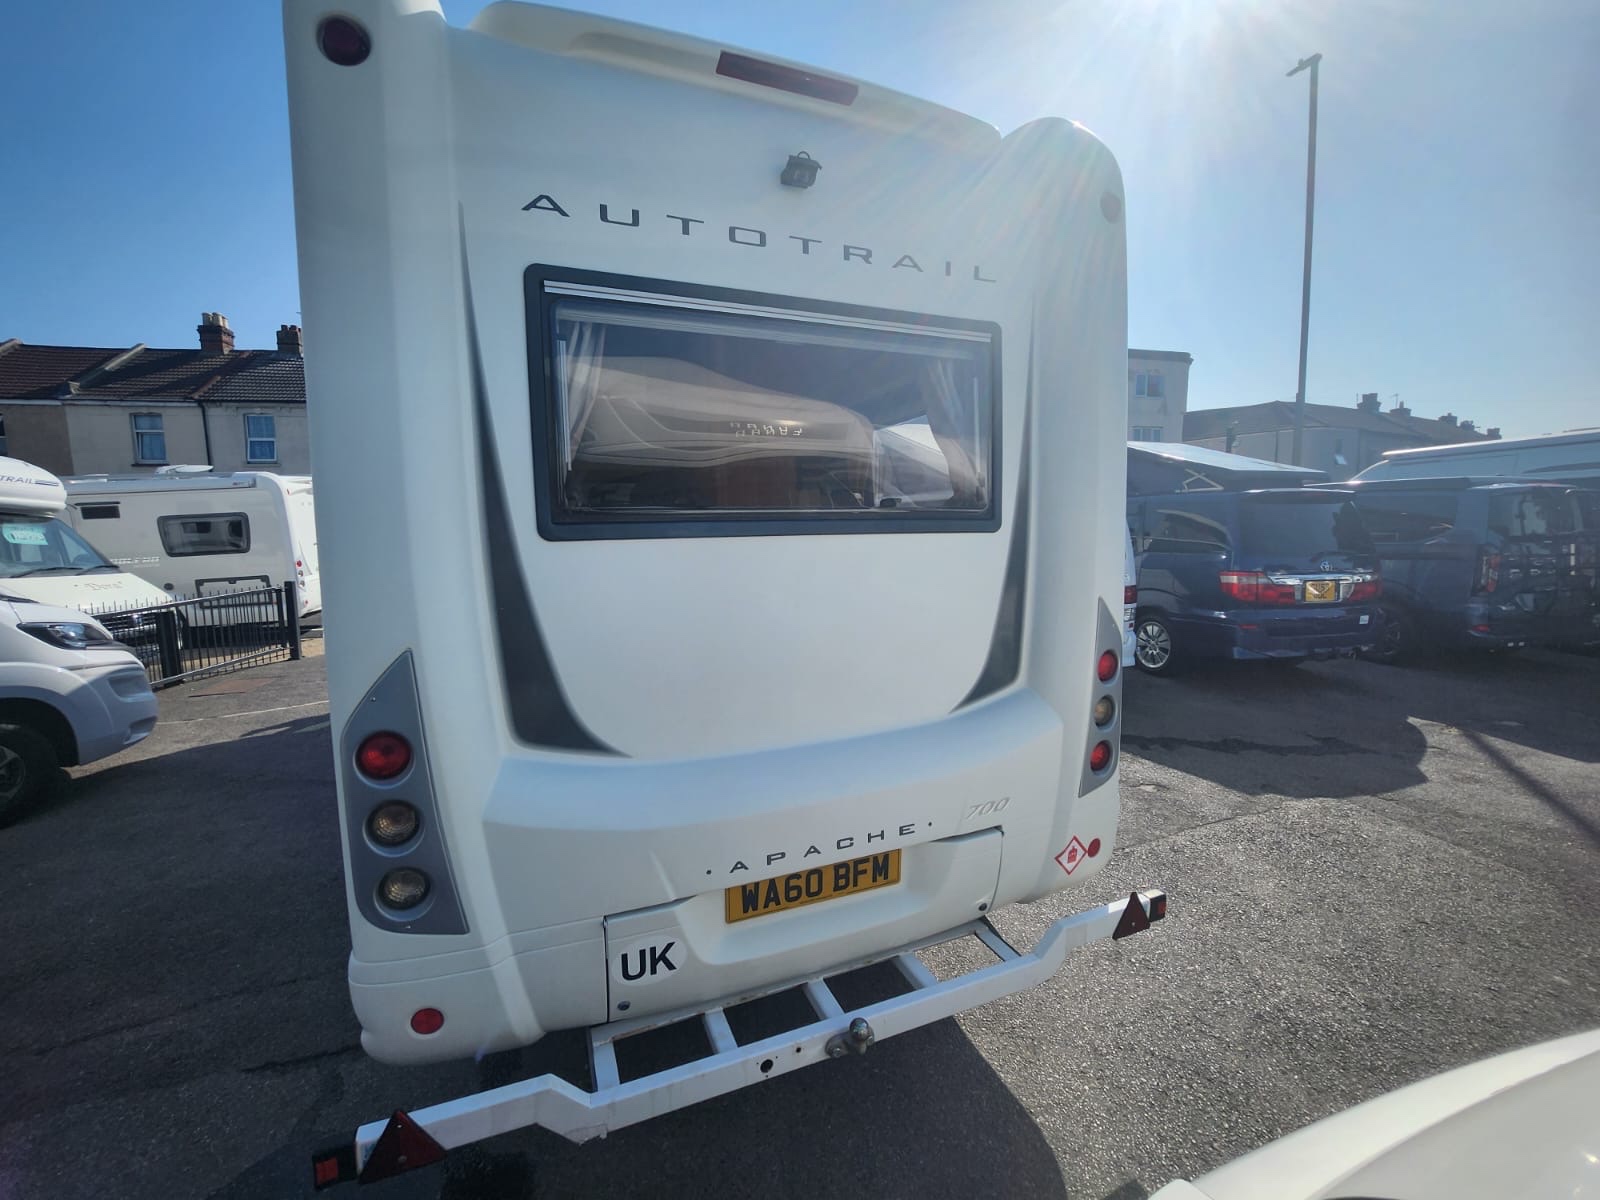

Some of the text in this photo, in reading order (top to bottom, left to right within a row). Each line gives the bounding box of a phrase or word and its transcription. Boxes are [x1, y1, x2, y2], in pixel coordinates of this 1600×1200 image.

[521, 194, 997, 283] AUTOTRAIL
[966, 797, 1010, 820] 700
[729, 823, 916, 874] APACHE
[741, 853, 890, 914] WA60 BFM
[620, 942, 677, 981] UK
